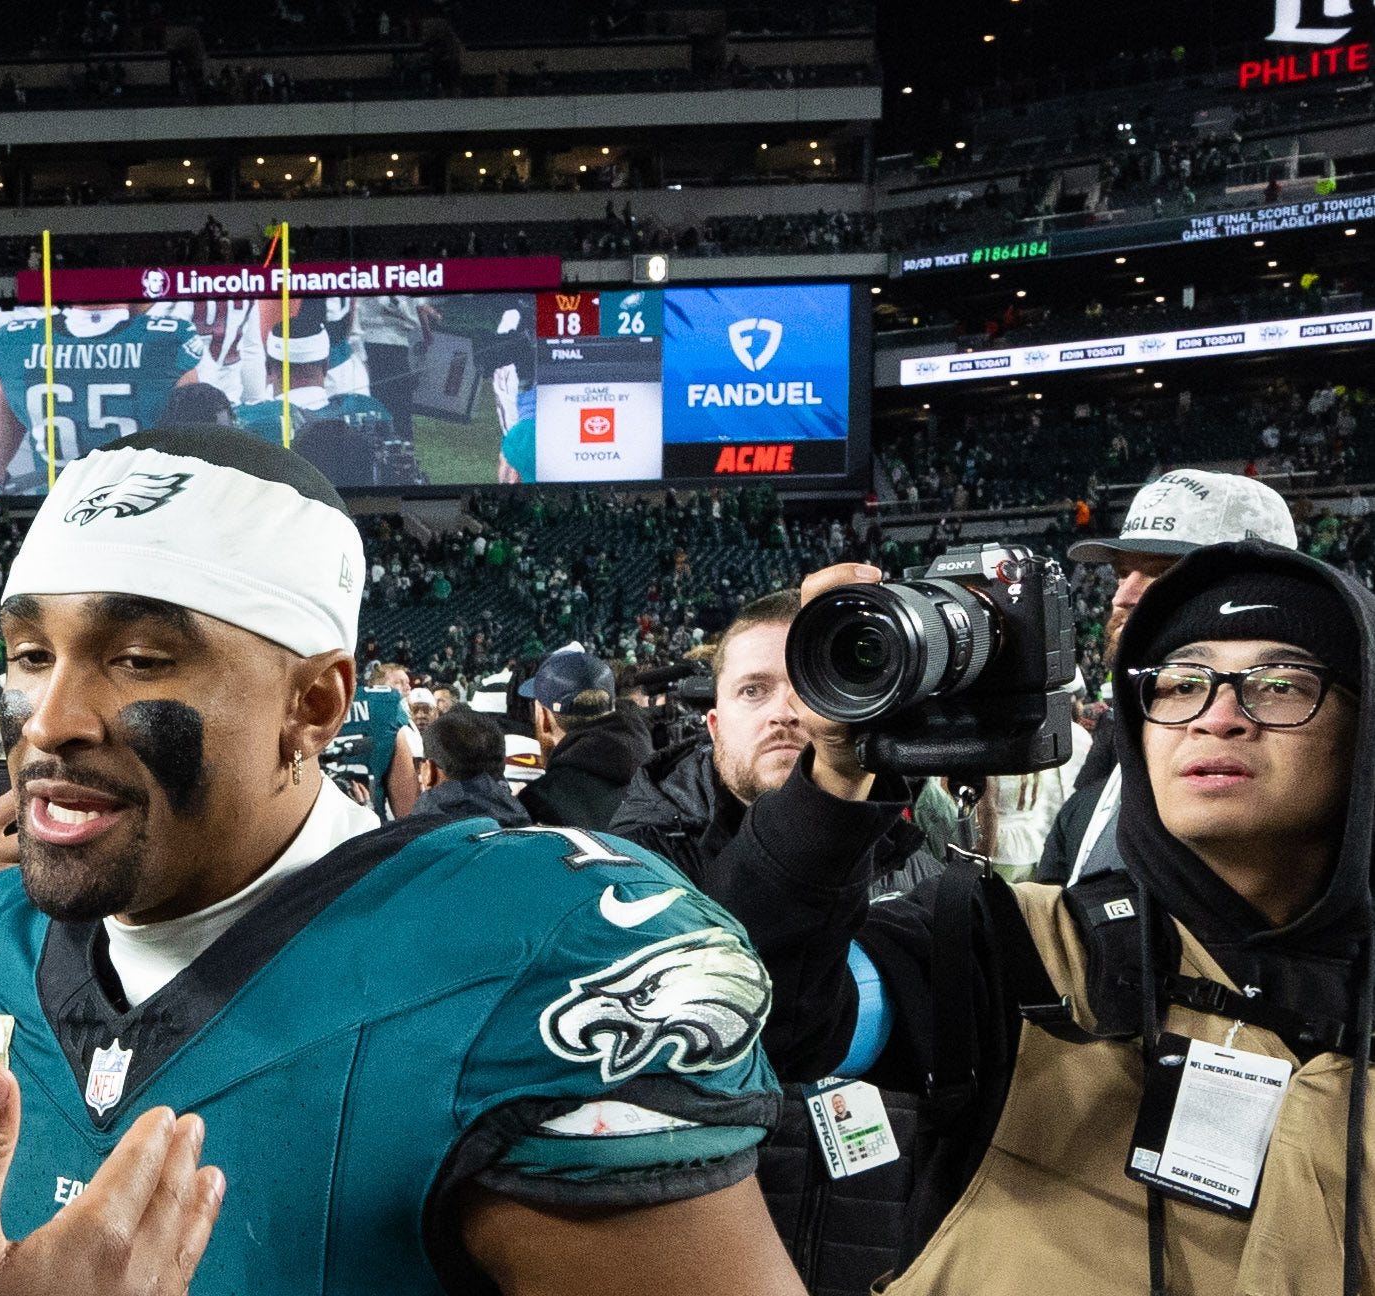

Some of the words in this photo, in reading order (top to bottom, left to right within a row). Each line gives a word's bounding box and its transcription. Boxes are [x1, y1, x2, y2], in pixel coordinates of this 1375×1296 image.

[1239, 43, 1369, 89] PHLITE
[1190, 217, 1214, 229] THE
[1217, 213, 1253, 227] FINAL
[1257, 205, 1299, 221] SCORE
[1302, 202, 1319, 216] OF
[1225, 223, 1248, 235] THE
[1251, 211, 1345, 233] PHILADELPHIA
[176, 267, 264, 295] Lincoln
[271, 264, 379, 293] Financial
[385, 262, 443, 288] Field
[555, 312, 582, 336] 18
[617, 311, 646, 335] 26
[24, 343, 143, 370] JOHNSON
[687, 382, 822, 407] FANDUEL
[574, 451, 621, 461] TOYOTA
[715, 445, 794, 473] ACME
[936, 560, 975, 571] SONY
[1203, 1063, 1244, 1079] CREDENTIAL
[91, 1074, 118, 1099] NFL
[813, 1100, 840, 1172] OFFICIAL
[1171, 1166, 1189, 1178] SCAN
[1202, 1175, 1227, 1192] ACCESS
